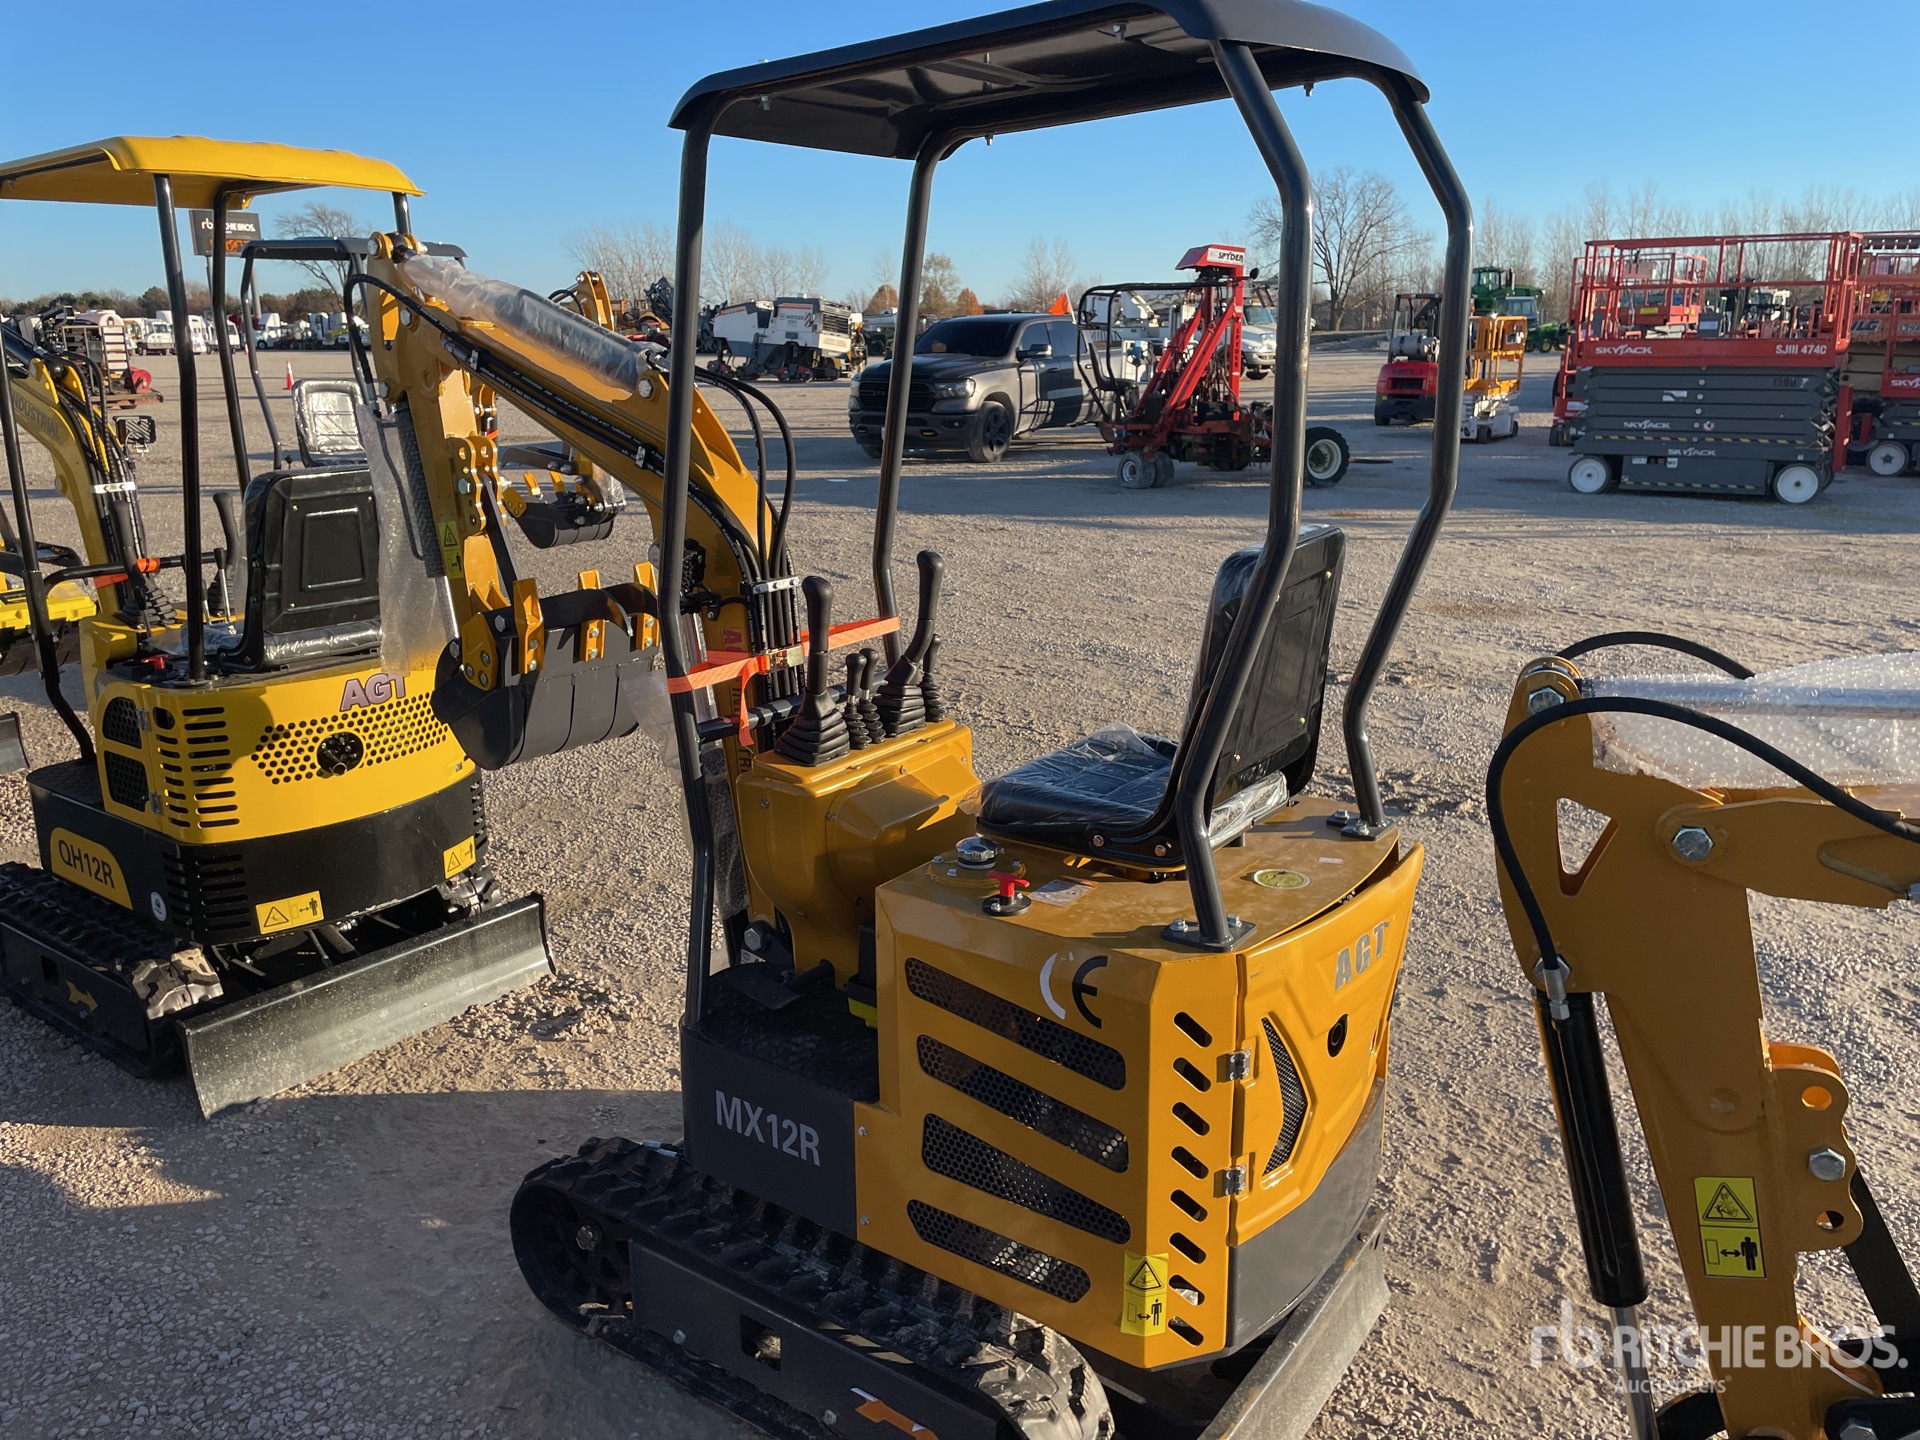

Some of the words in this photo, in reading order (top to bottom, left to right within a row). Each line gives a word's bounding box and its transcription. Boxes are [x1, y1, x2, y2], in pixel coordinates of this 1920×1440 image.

[1218, 251, 1244, 263] SPYDER
[1595, 344, 1652, 355] SKYJACK
[1775, 344, 1799, 355] SJIII
[1800, 344, 1828, 355] 474C
[1623, 419, 1670, 430] SKYJACK
[1667, 447, 1716, 457] SKYJACK
[339, 673, 406, 712] AGT
[59, 839, 116, 890] QH12R
[1335, 921, 1390, 992] AGT
[715, 1089, 821, 1167] MX12R
